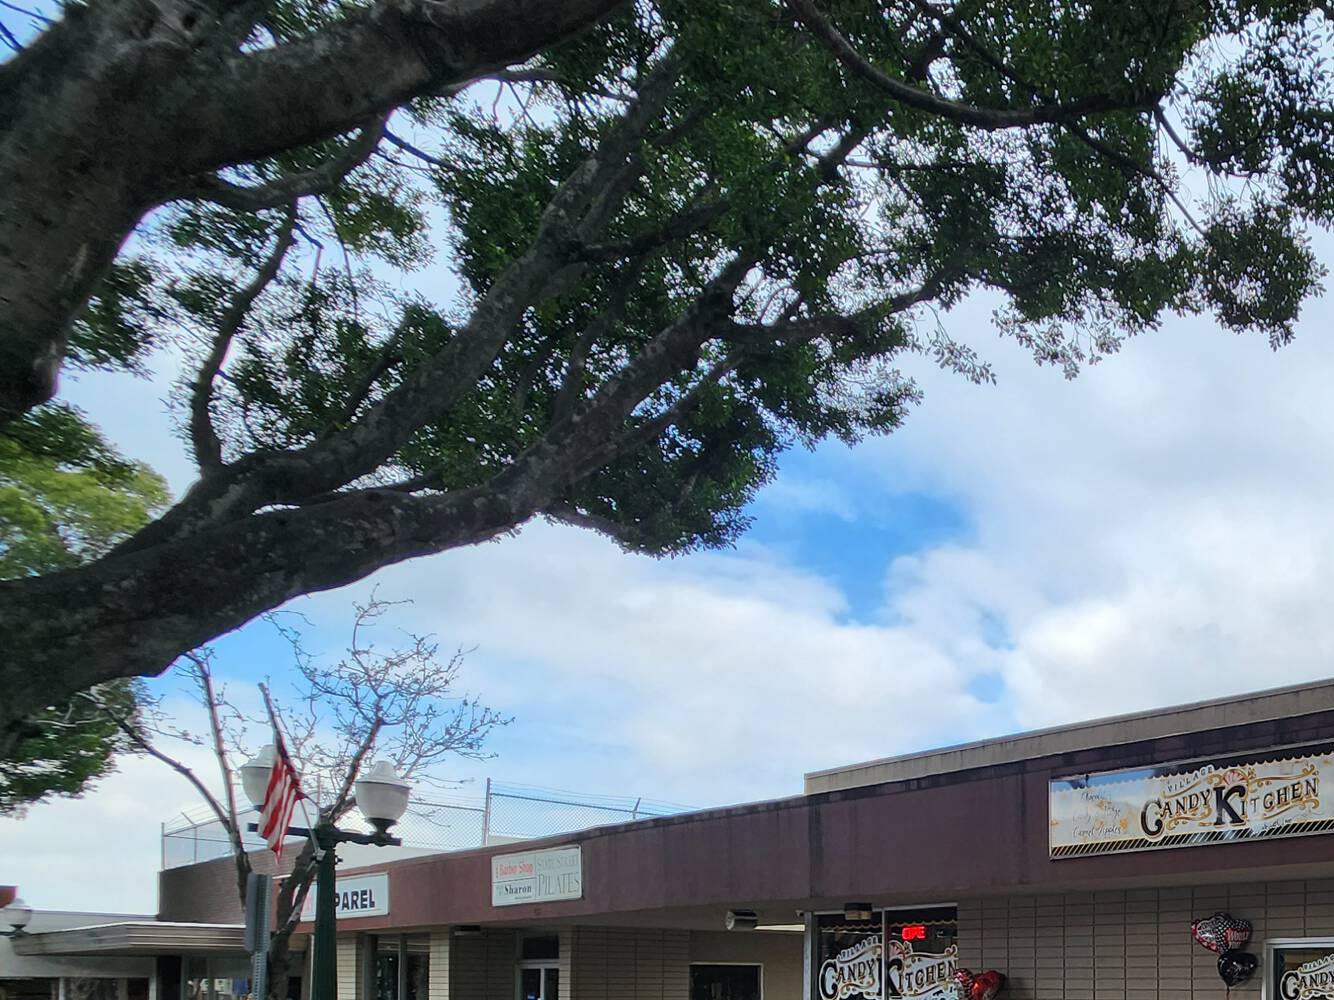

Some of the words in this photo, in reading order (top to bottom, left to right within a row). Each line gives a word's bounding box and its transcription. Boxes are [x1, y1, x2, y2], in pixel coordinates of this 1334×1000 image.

[1167, 766, 1213, 792] VILLAGE
[1141, 789, 1213, 837] CANDY
[1213, 777, 1319, 826] KITCHEN
[504, 884, 532, 895] Sharon
[538, 872, 580, 896] PILATES
[821, 959, 876, 1000] CANDY
[877, 957, 958, 997] KITCHEN
